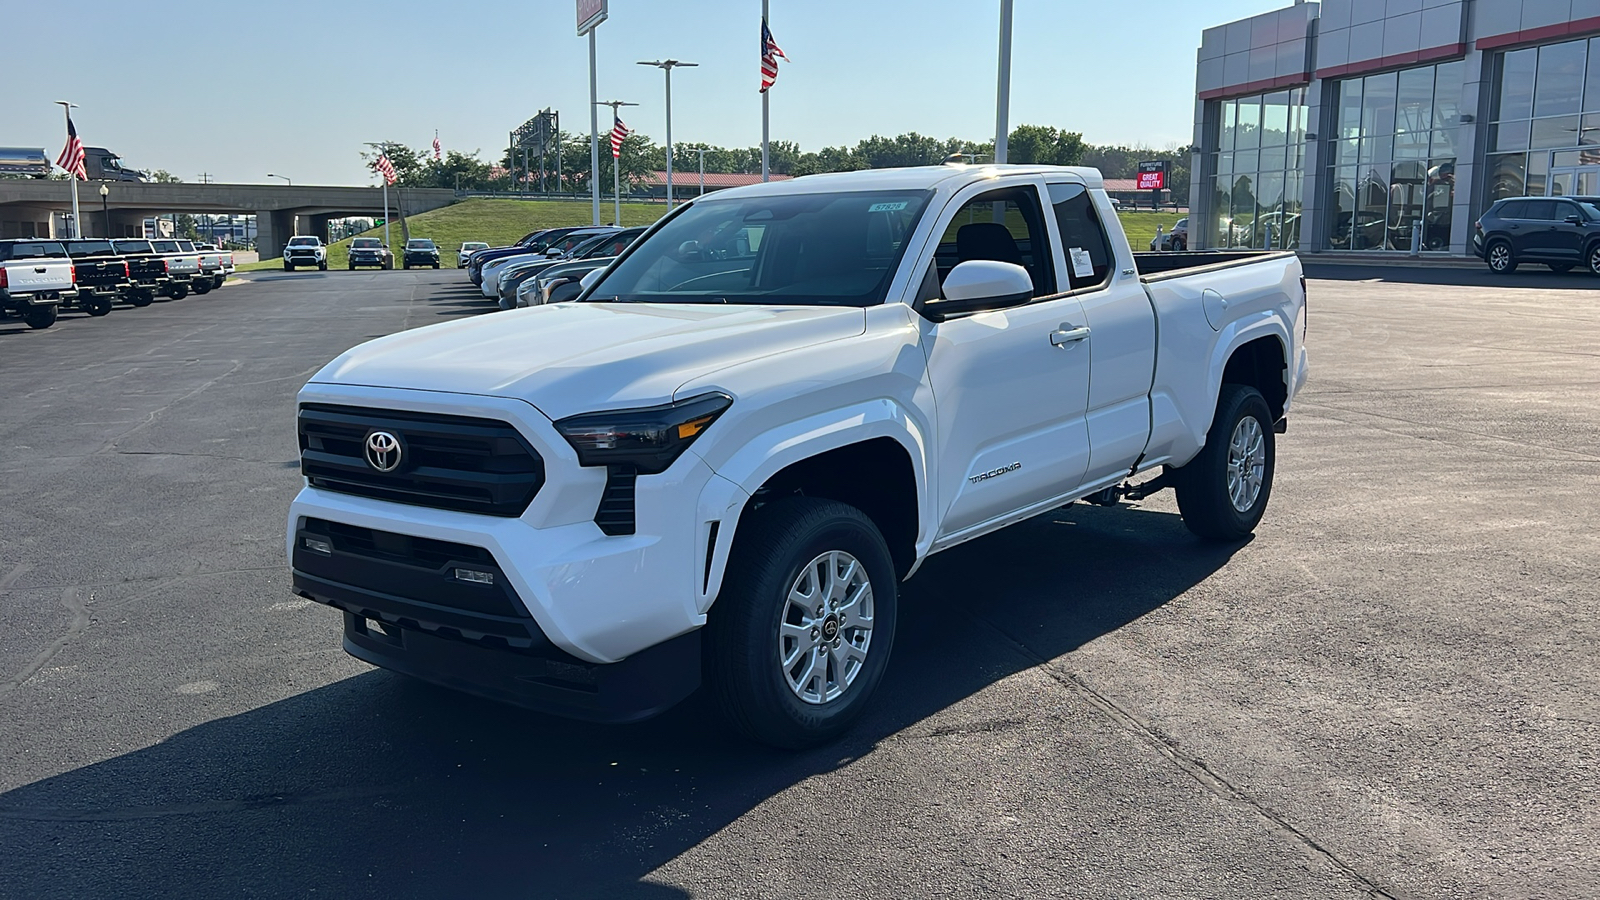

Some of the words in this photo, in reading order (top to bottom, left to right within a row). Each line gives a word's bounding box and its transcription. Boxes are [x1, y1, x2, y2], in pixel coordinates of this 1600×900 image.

[1142, 173, 1158, 181] GREAT
[1140, 180, 1160, 188] QUALITY
[968, 461, 1022, 484] TACOMA
